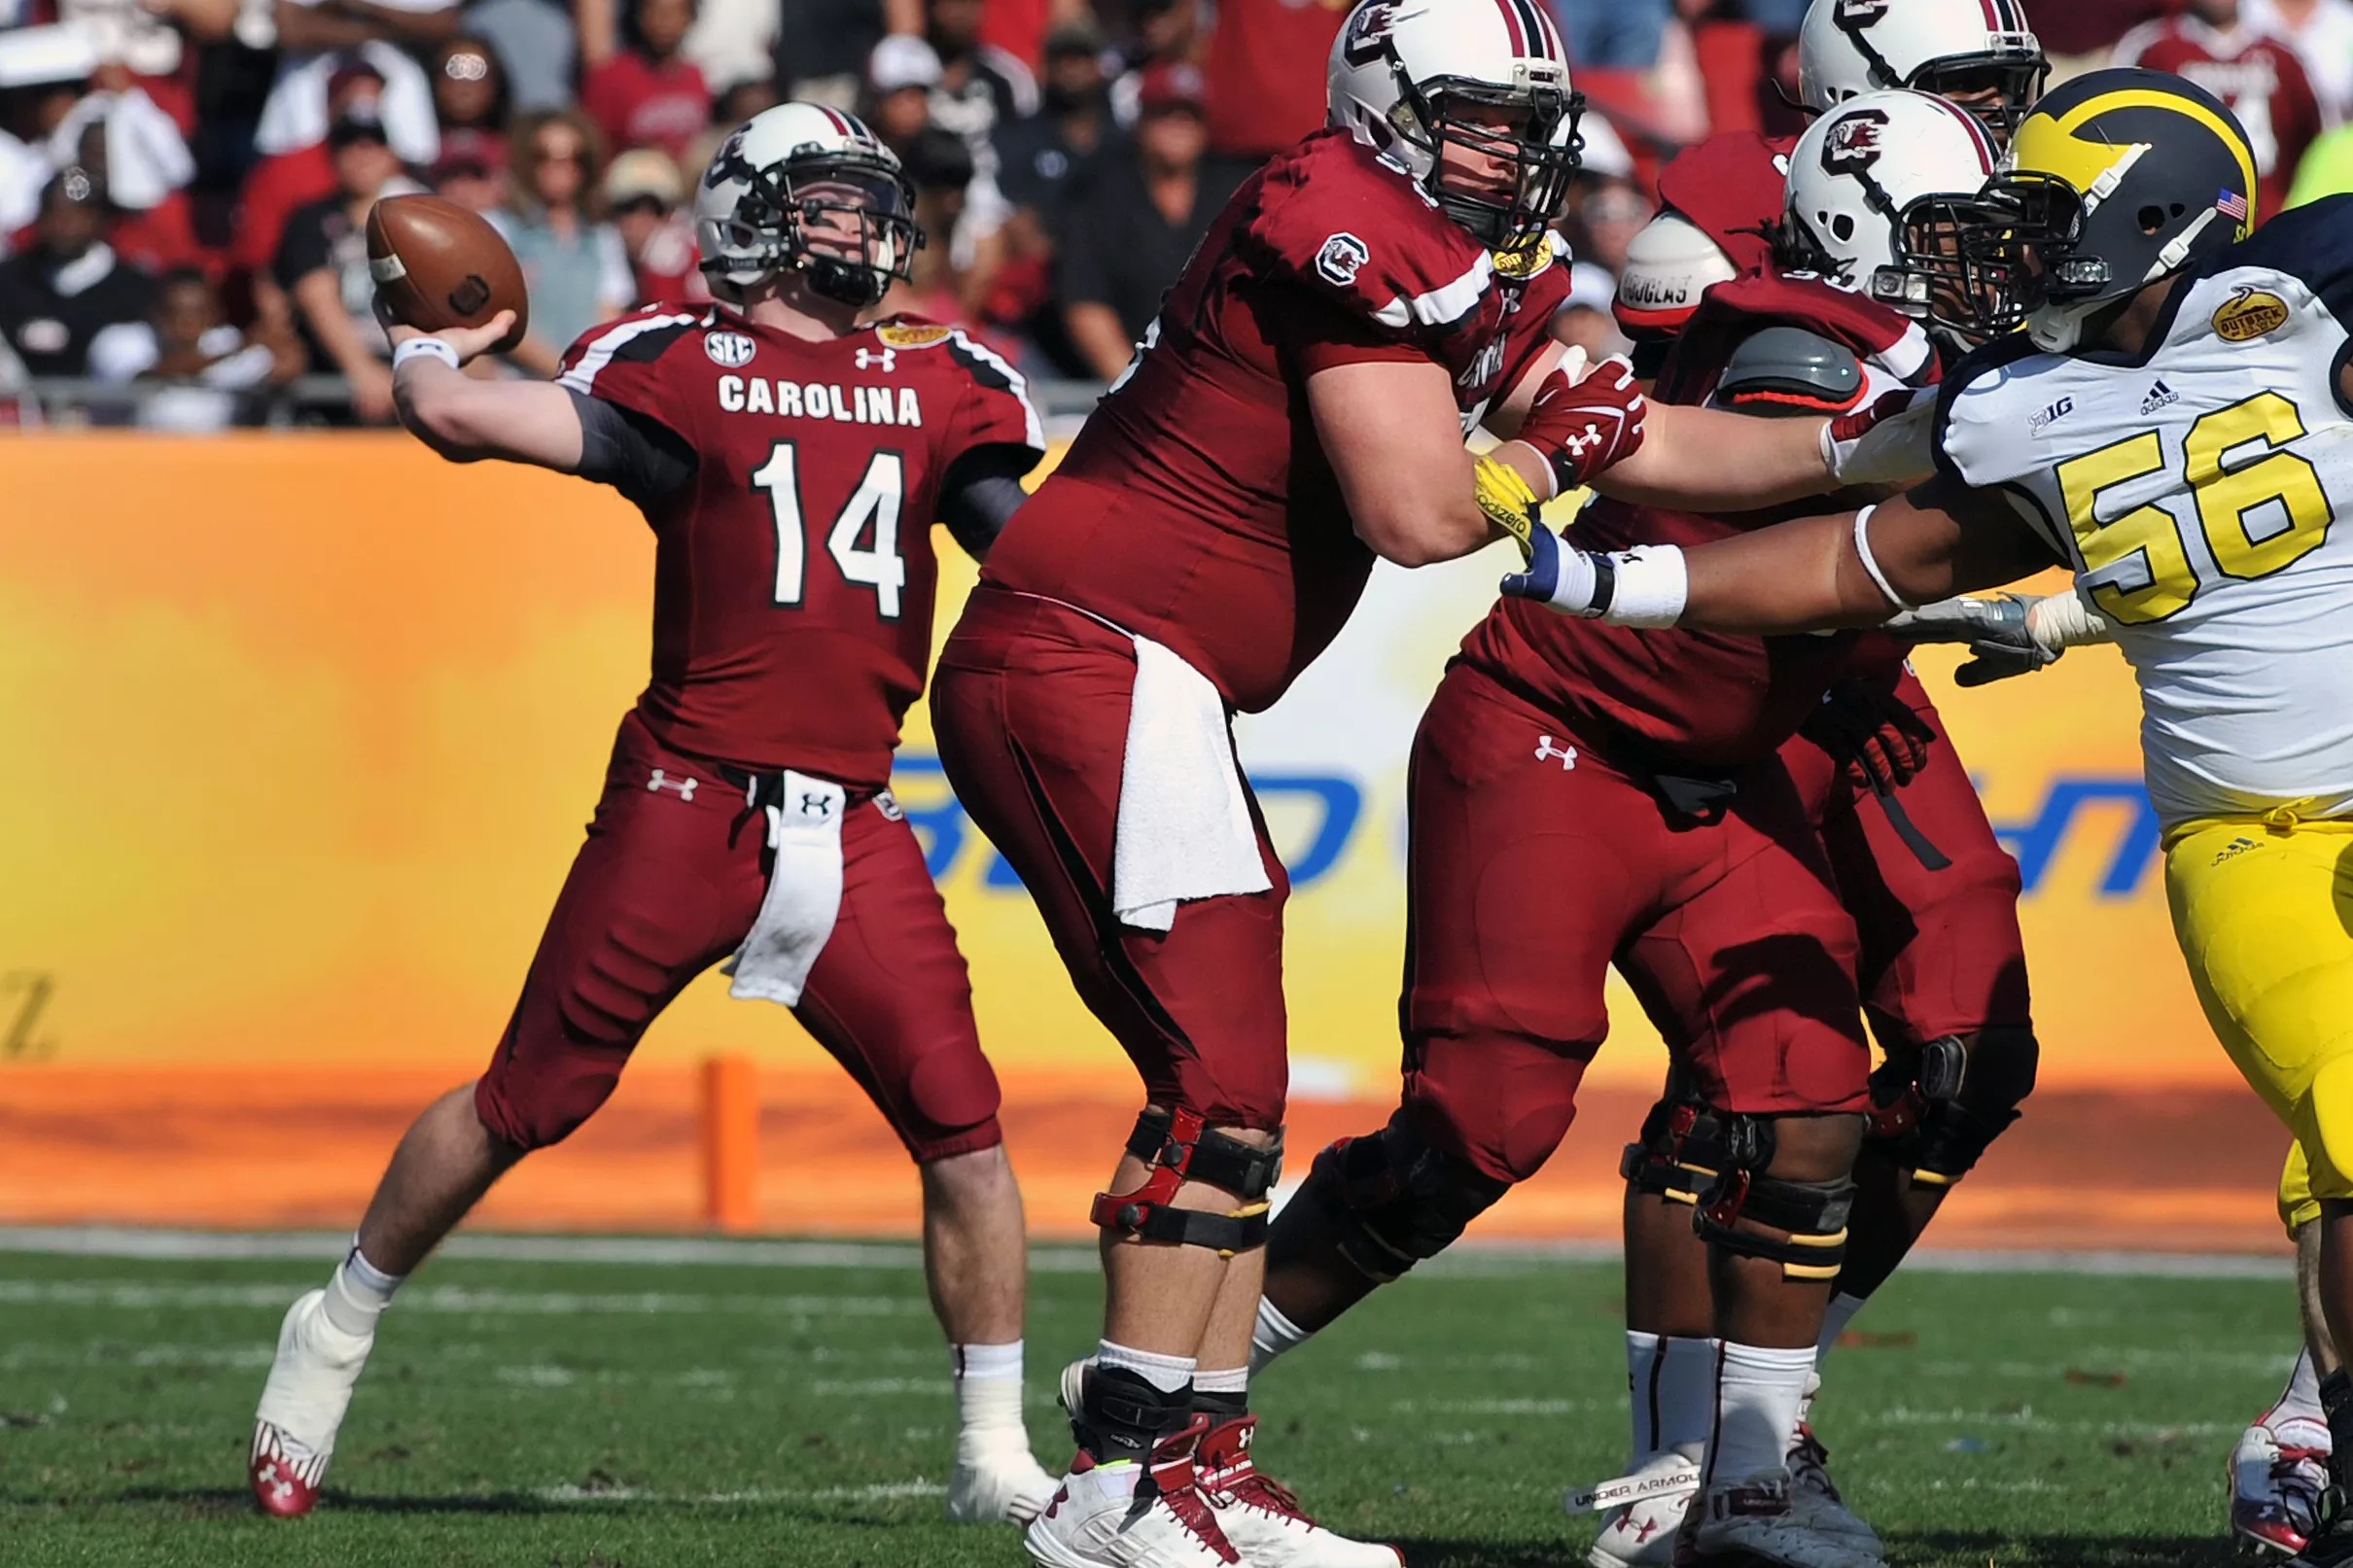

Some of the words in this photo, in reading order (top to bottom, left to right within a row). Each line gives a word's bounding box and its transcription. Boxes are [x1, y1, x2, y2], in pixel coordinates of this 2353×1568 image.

[708, 333, 755, 365] SEC
[718, 374, 923, 428] CAROLINA
[751, 438, 906, 622] 14
[1476, 492, 1528, 535] adizero
[2054, 389, 2335, 627] 56
[1575, 1484, 1632, 1507] UNDER
